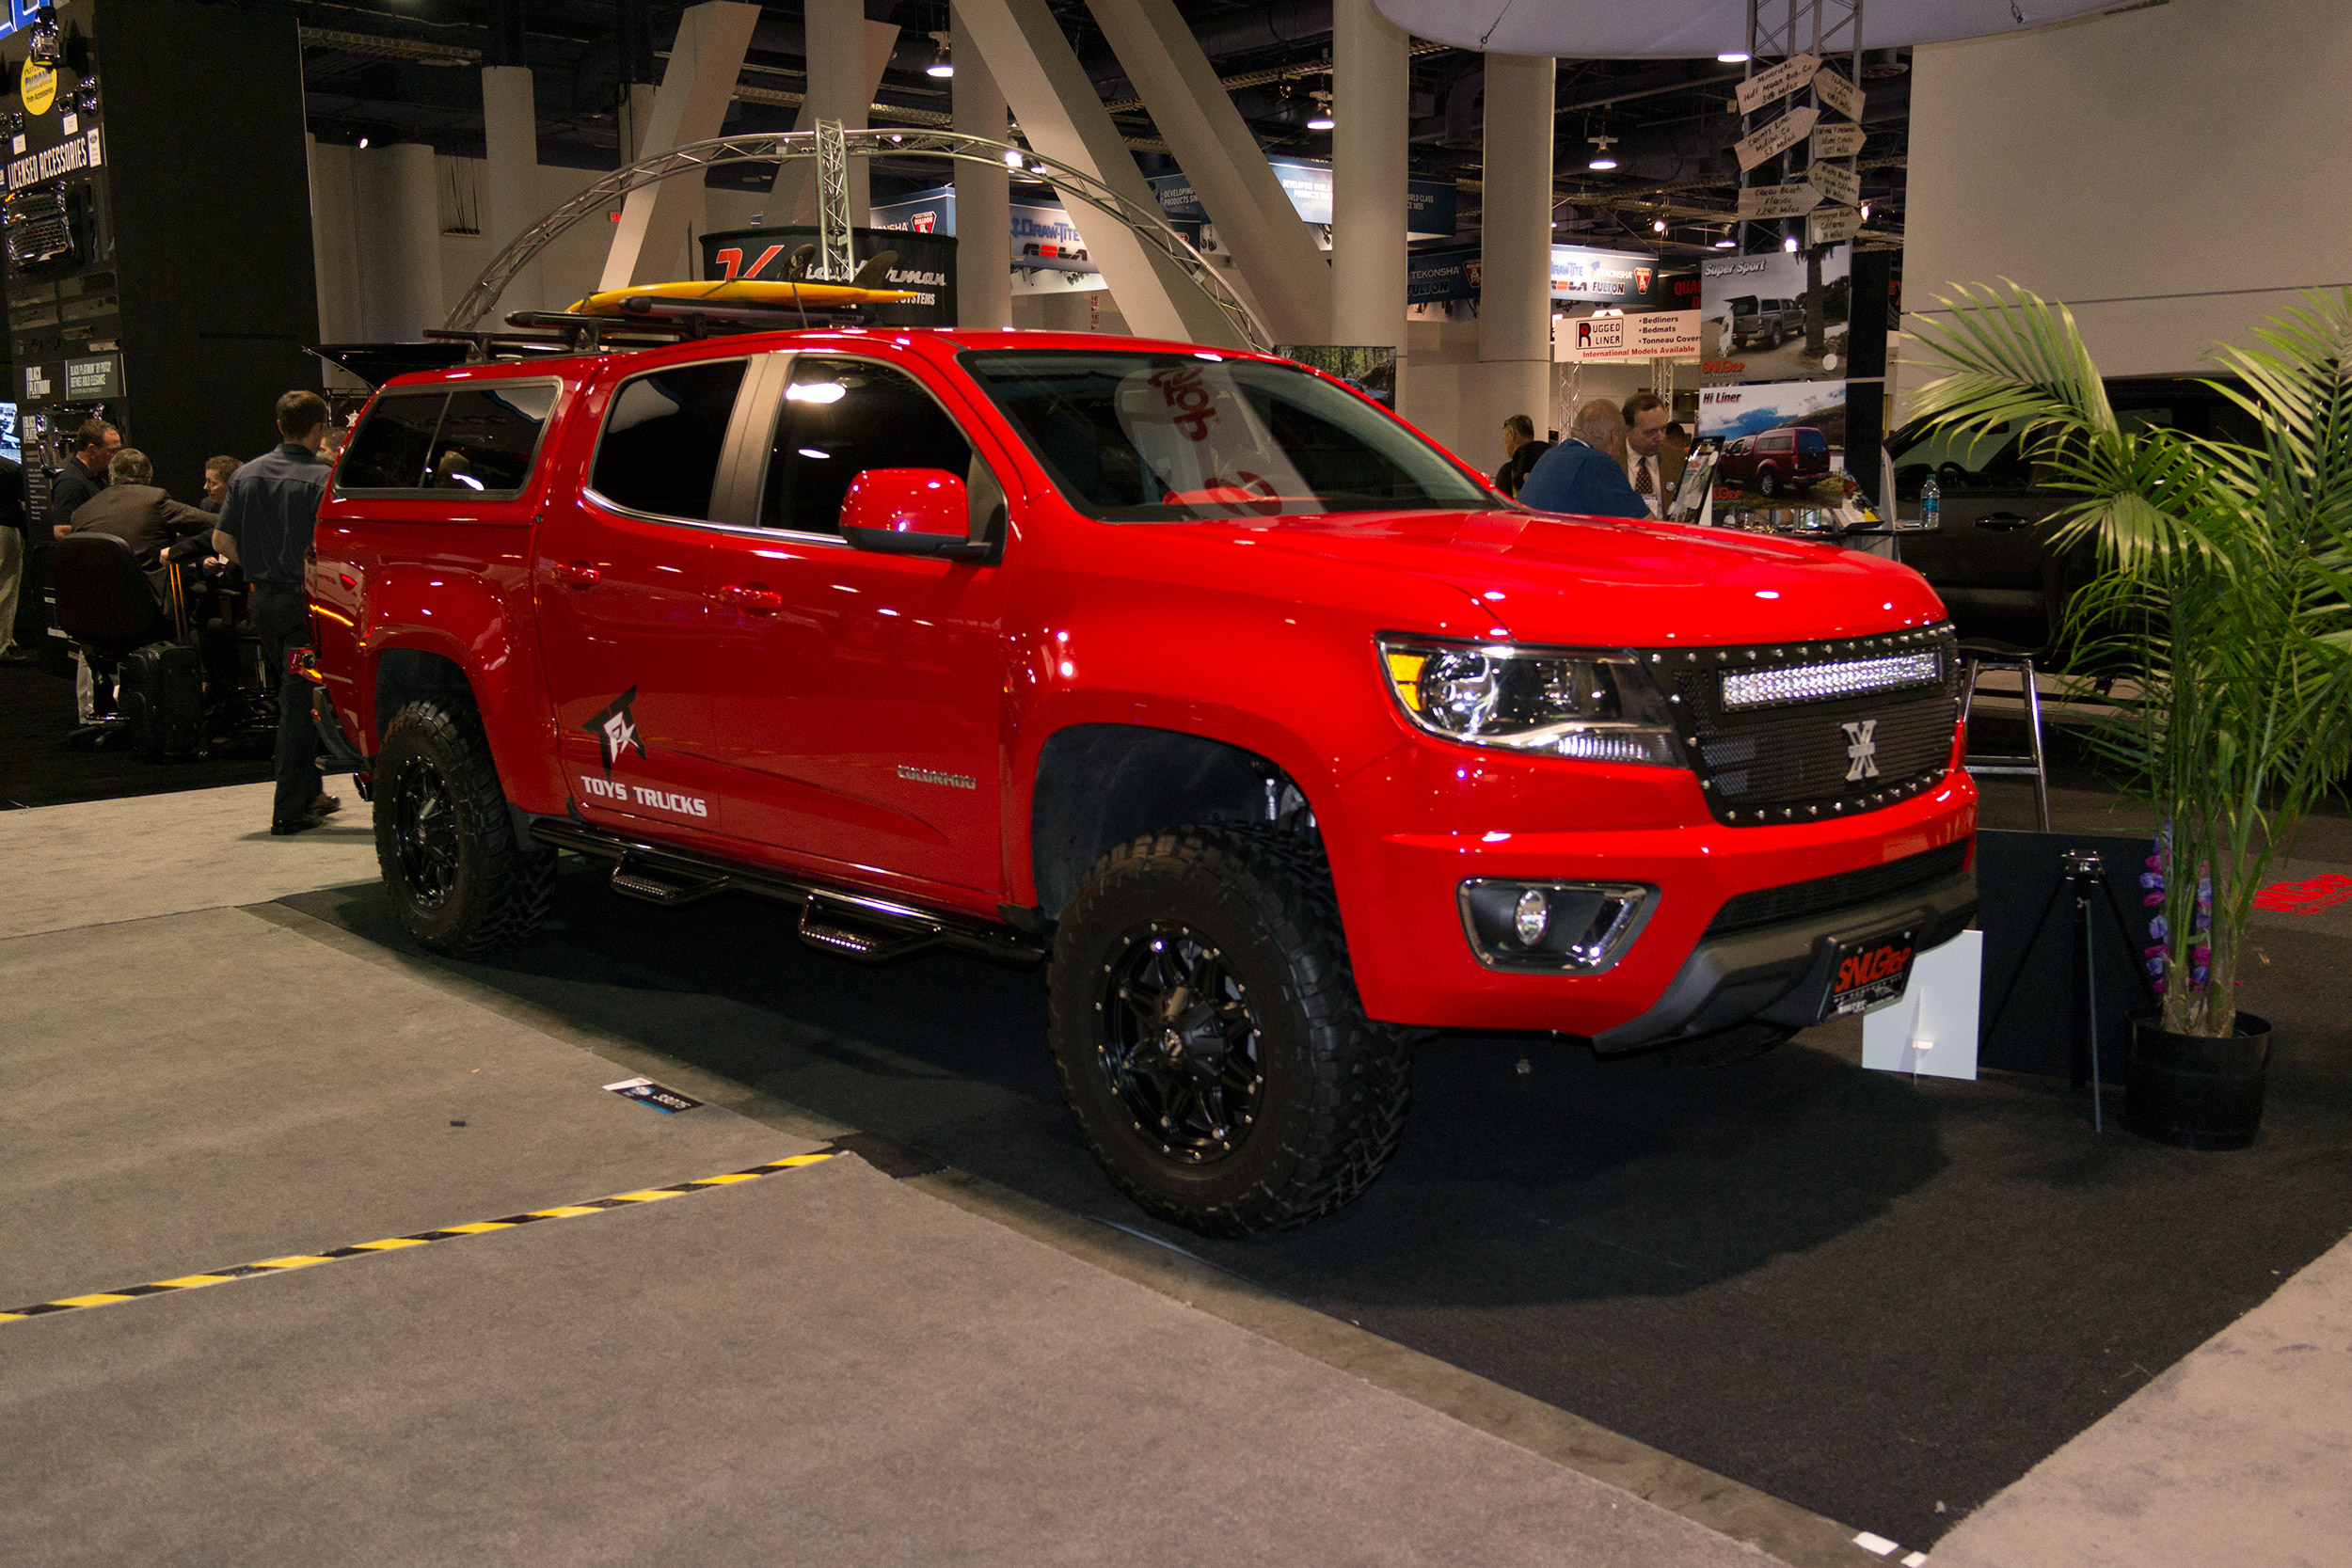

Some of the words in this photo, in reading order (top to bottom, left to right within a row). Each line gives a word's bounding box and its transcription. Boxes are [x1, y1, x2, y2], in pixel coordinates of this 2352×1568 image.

[8, 155, 40, 191] LICENSED
[39, 136, 87, 181] ACCESSORIES
[1164, 197, 1189, 207] PRODUCTS
[1420, 195, 1434, 203] CLASS
[1411, 266, 1460, 279] TEKONSHA
[1705, 262, 1735, 278] Super
[1737, 259, 1766, 276] Sport
[1592, 282, 1626, 294] FULTON
[1643, 316, 1678, 325] Bedliners
[1596, 335, 1621, 345] LINER
[1643, 337, 1675, 345] Tonneau
[1582, 349, 1629, 358] International
[1631, 347, 1658, 356] Models
[1660, 345, 1695, 354] Available
[1703, 392, 1713, 404] Hi
[1716, 392, 1741, 404] Liner
[580, 775, 628, 800] TOYS
[633, 786, 707, 817] TRUCKS
